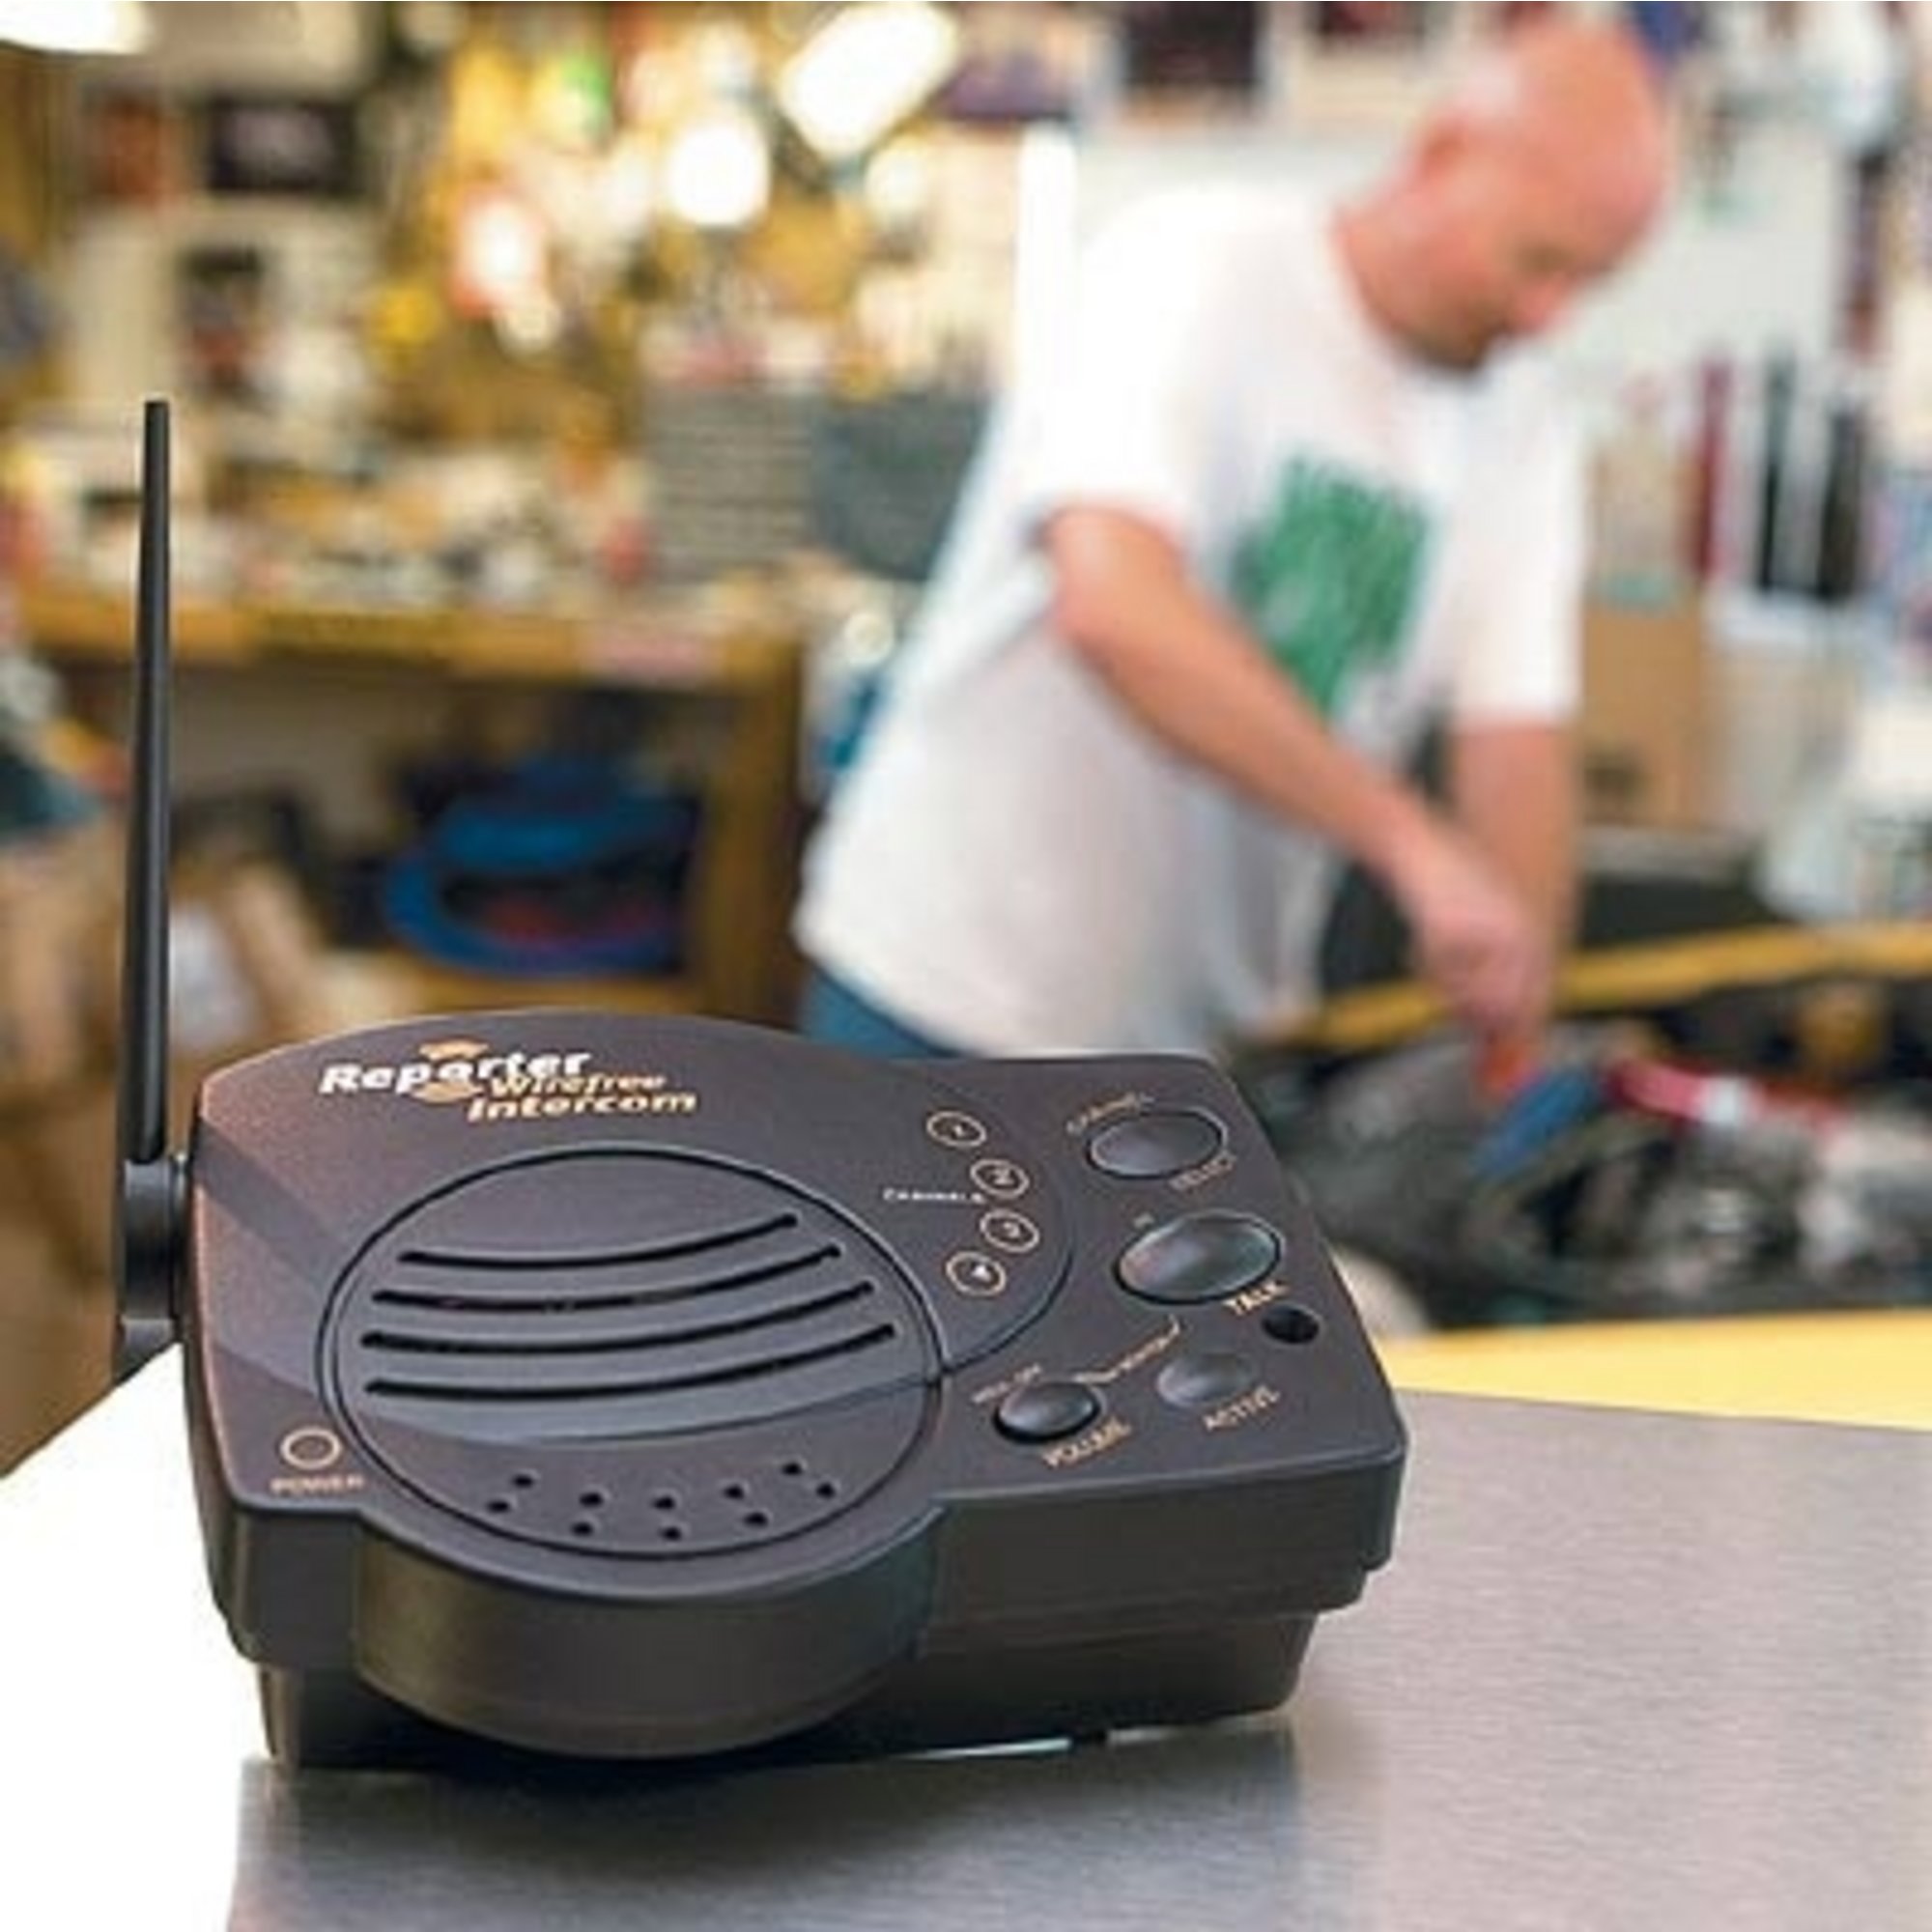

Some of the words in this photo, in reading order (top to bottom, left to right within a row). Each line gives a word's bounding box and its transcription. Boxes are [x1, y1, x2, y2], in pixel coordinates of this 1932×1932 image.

[318, 1049, 592, 1095] Reporter
[467, 1089, 696, 1123] Intercom
[1221, 1278, 1289, 1316] TALK
[1202, 1385, 1281, 1431] ACTIVE
[1041, 1416, 1132, 1468] VOLUME
[269, 1472, 364, 1495] POWER
